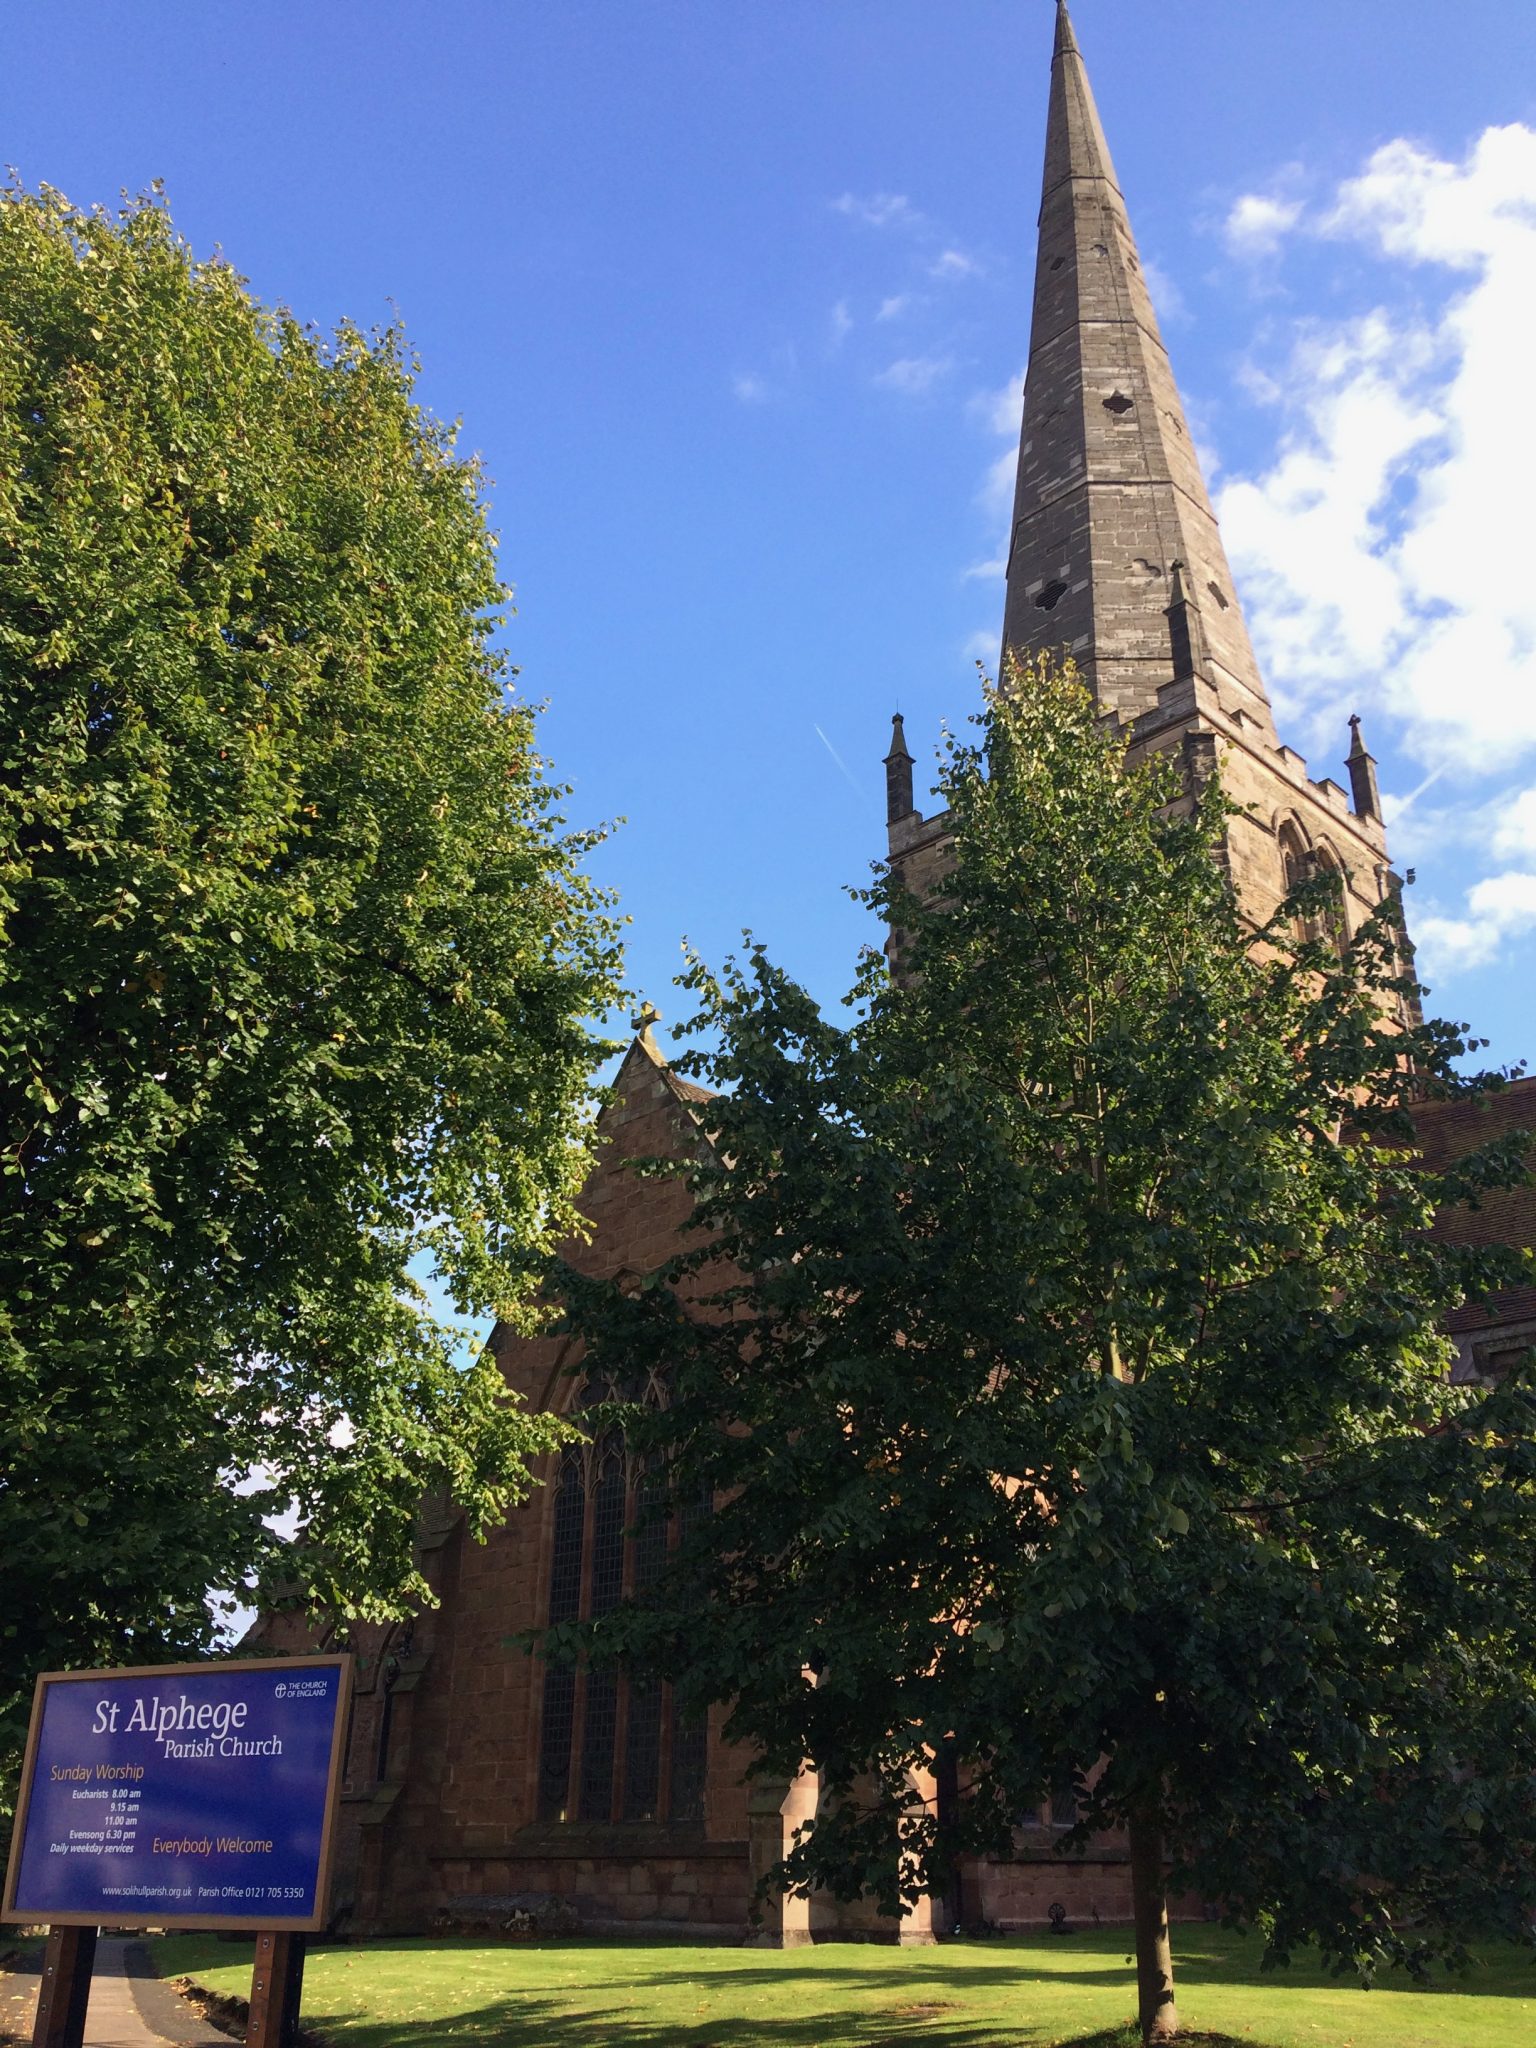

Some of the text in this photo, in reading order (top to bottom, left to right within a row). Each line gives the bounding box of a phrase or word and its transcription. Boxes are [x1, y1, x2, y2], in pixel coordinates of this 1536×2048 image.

[301, 1681, 327, 1689] CHURCH
[287, 1689, 326, 1698] OF ENGLAND
[92, 1695, 248, 1741] St Alphege
[163, 1735, 283, 1759] Parish Church
[50, 1763, 144, 1783] Sunday Worship
[72, 1789, 141, 1799] Eucharists 8.00 am
[110, 1802, 139, 1812] 9.15 am
[104, 1816, 137, 1826] 11.00 am
[70, 1830, 136, 1841] Evensong 6.30 pm
[50, 1843, 134, 1855] Daily weekday services
[153, 1837, 273, 1857] Everybody Welcome
[102, 1886, 192, 1899] www.solihullparish.org.uk
[198, 1887, 304, 1898] Parish Office 0121 705 5350
